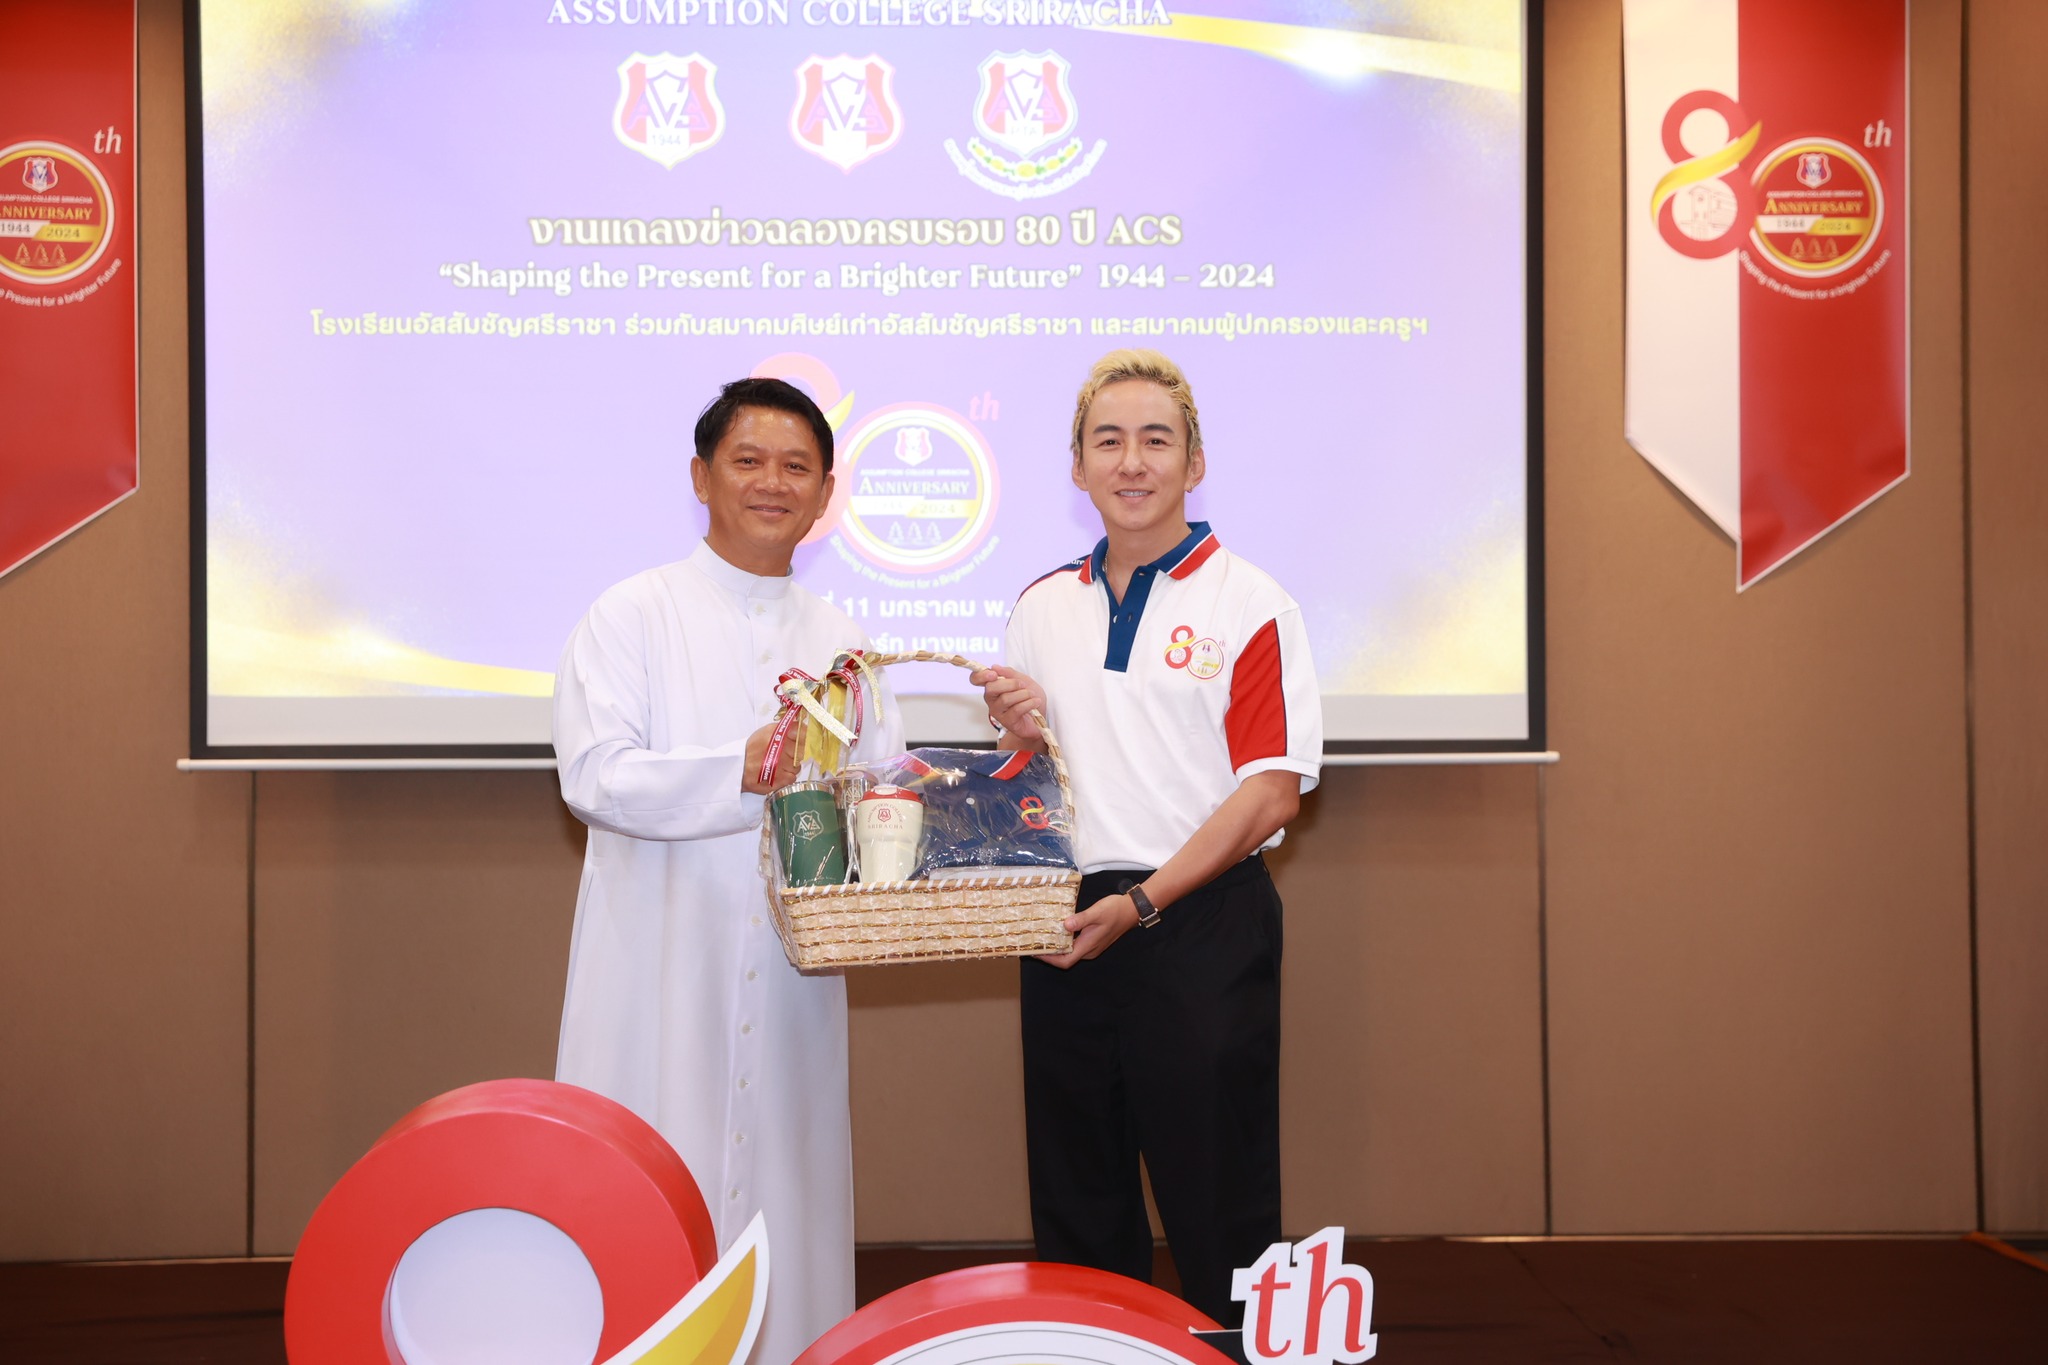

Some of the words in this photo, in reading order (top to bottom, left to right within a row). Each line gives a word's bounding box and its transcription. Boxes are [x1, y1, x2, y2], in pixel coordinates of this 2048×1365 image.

[547, 0, 789, 26] ASSUMPTION
[803, 0, 970, 26] COLLEGE
[983, 0, 1172, 26] SRIRACHA
[93, 126, 122, 154] th
[651, 134, 681, 146] 1944
[1864, 119, 1892, 148] th
[0, 205, 93, 220] NNIVERSARY
[1764, 198, 1863, 214] ANNIVERSARY
[1, 223, 30, 233] 1944
[528, 206, 1004, 246] งานแถลงข่าวฉลองครบรอบ
[1015, 214, 1060, 246] 80
[1070, 207, 1097, 246] ปี
[1106, 214, 1183, 246] ACS
[580, 261, 629, 289] the
[637, 264, 753, 289] Present
[761, 261, 806, 289] for
[814, 269, 832, 289] a
[840, 261, 962, 297] Brighter
[1099, 264, 1166, 289] 1944
[1199, 264, 1275, 289] 2024
[310, 309, 616, 337] โรงเรียนอัสสัมชัญศรีราชา
[625, 311, 1082, 337] ร่วมกับสมาคมศิษย์เก่าอัสสัมชัญศรีราชา
[1091, 311, 1428, 341] และสมาคมผู้ปกครองและครูฯ
[968, 391, 1000, 421] th
[858, 476, 970, 495] ANNIVERSARY
[843, 597, 869, 618] 11
[880, 599, 976, 618] มกราคม
[1251, 1241, 1366, 1359] th
